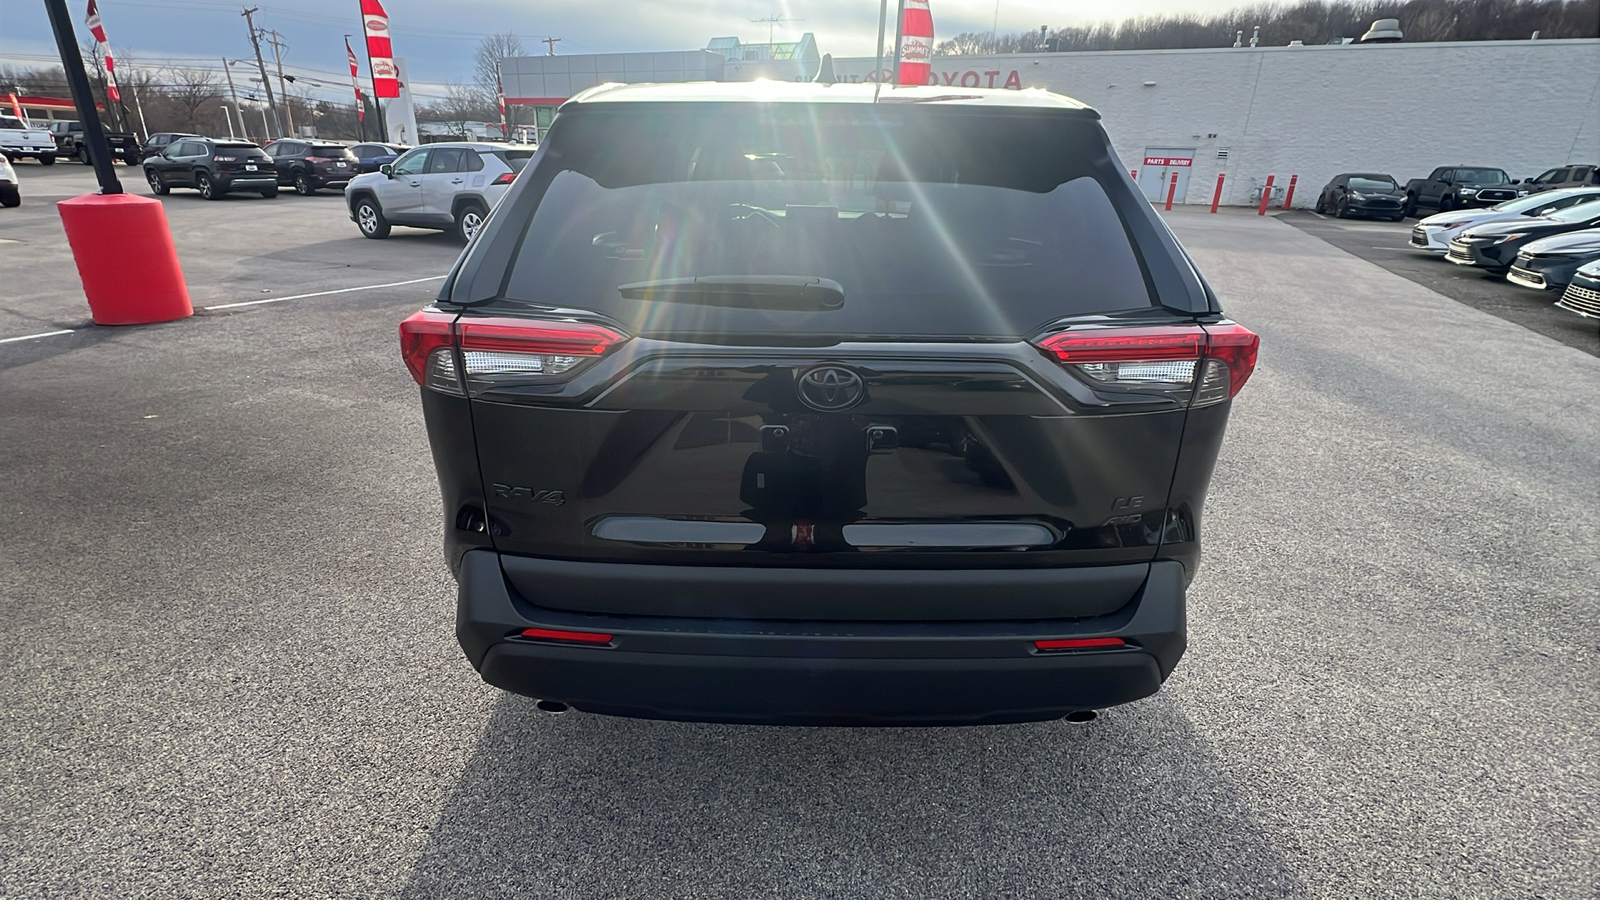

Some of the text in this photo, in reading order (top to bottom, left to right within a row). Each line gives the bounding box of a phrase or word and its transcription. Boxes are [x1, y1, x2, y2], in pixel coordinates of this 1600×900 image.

[901, 44, 930, 58] SUMMIT
[795, 70, 1022, 90] SUIT OYOTA
[492, 483, 565, 506] RAV4
[1111, 495, 1144, 510] LE
